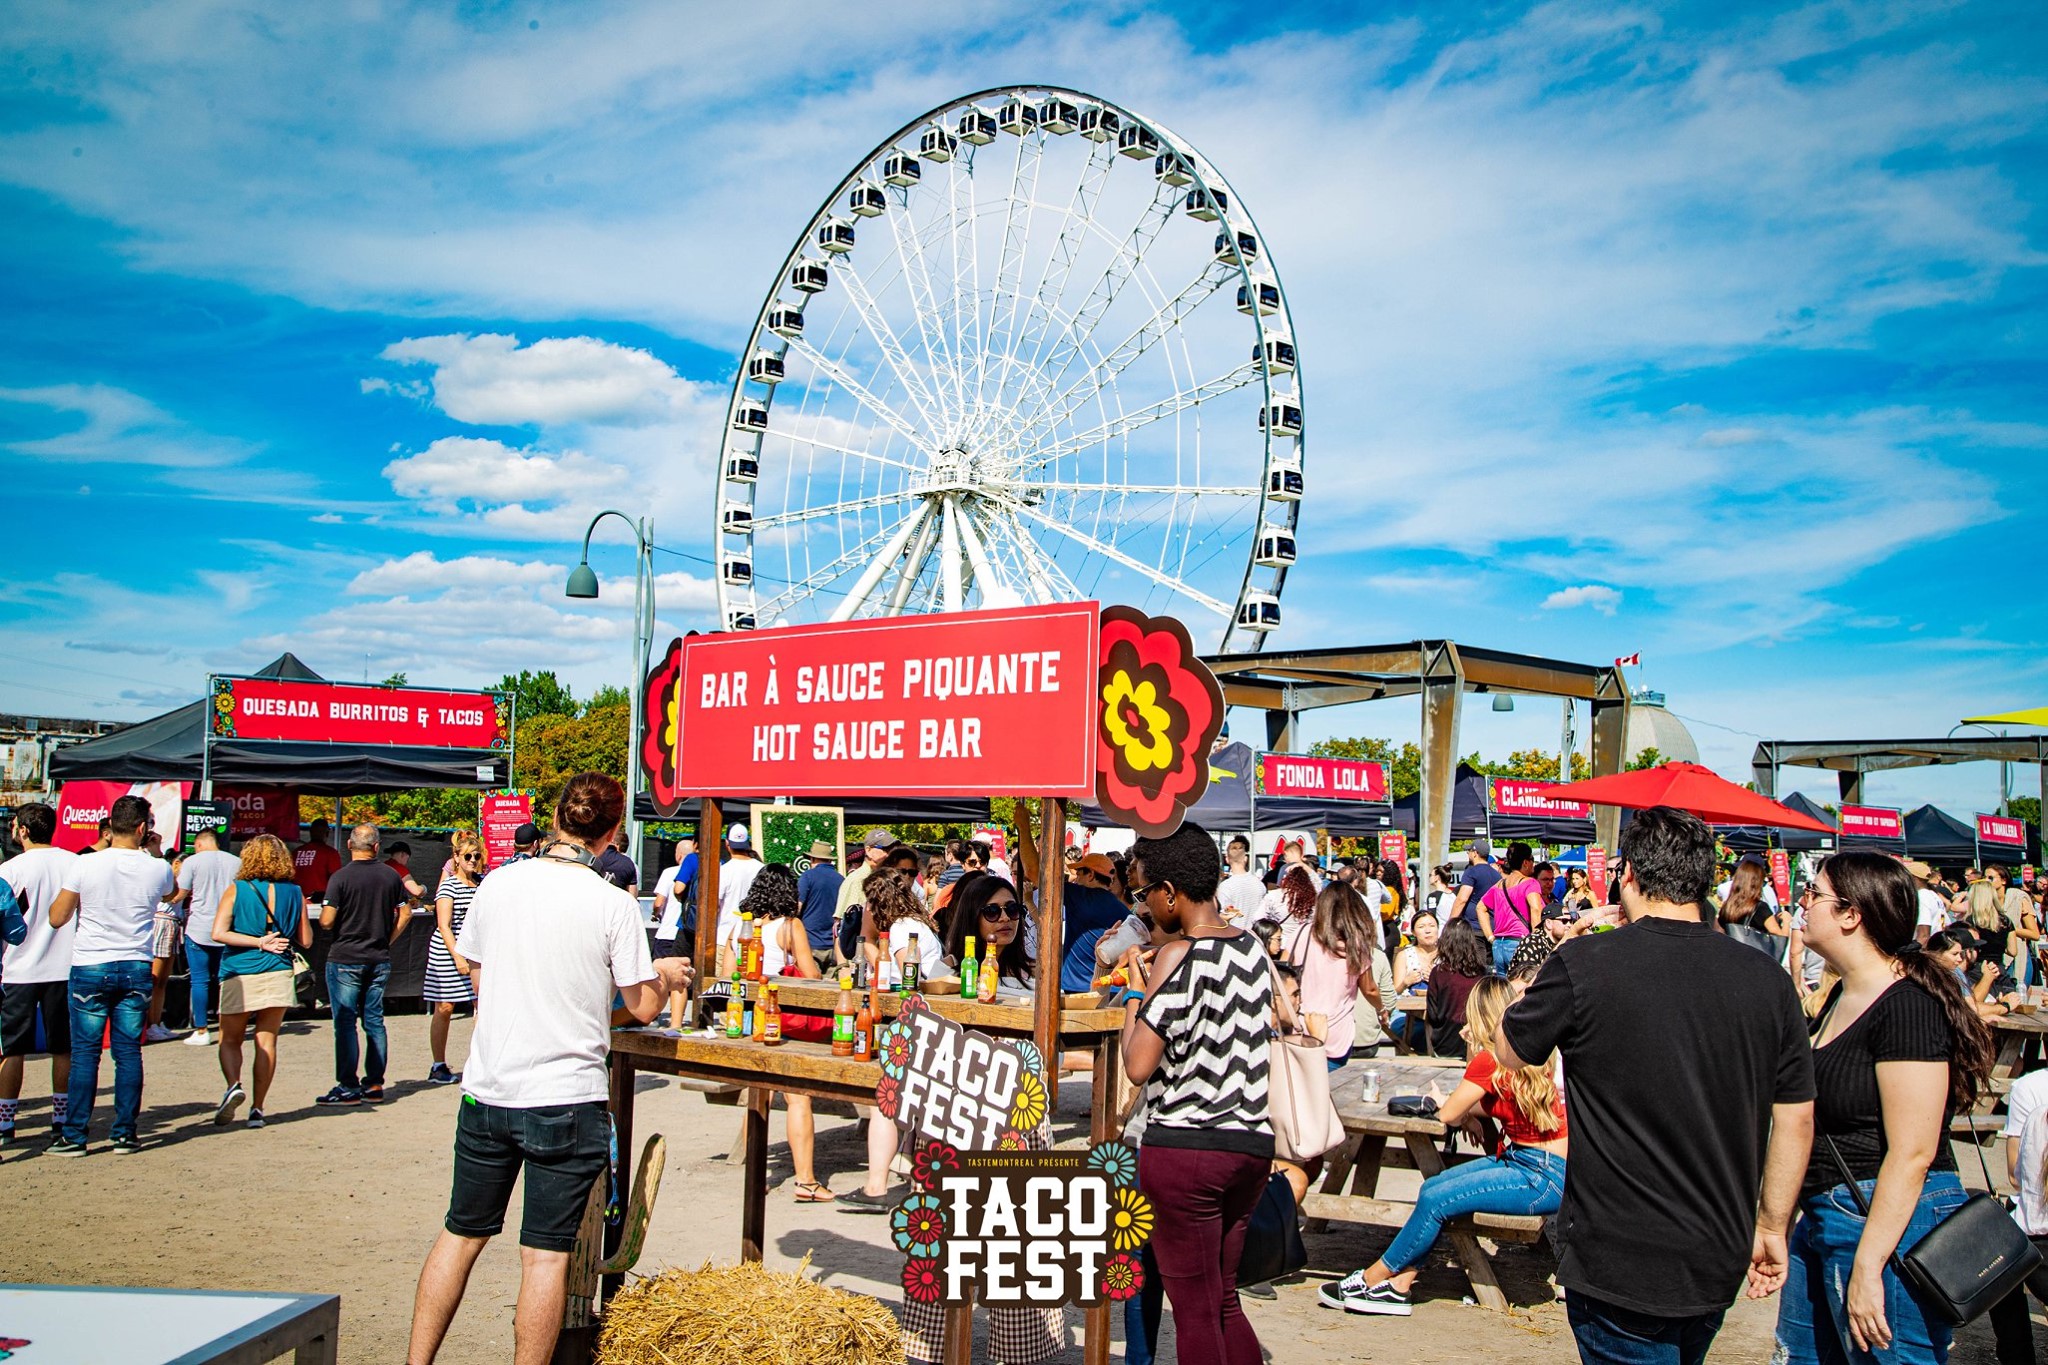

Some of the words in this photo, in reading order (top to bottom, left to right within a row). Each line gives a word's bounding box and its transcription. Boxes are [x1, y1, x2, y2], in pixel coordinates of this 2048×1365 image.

[701, 671, 747, 708] BAR
[763, 655, 779, 705] À
[797, 661, 885, 704] SAUCE
[903, 651, 1061, 701] PIQUANTE
[243, 698, 319, 718] QUESADA
[330, 703, 408, 722] BURRITOS
[418, 708, 429, 728] &
[439, 709, 484, 726] TACOS
[752, 724, 801, 762] HOT
[812, 719, 903, 760] SAUCE
[918, 717, 982, 758] BAR
[1276, 764, 1325, 789] FONDA
[1333, 768, 1370, 792] LOLA
[62, 805, 109, 825] Quesada
[186, 814, 228, 825] BEYOND
[1983, 821, 1991, 834] LA
[295, 857, 314, 867] FEST
[297, 850, 317, 859] TACO
[912, 1013, 1019, 1110] TACO
[898, 1069, 1008, 1151] FEST
